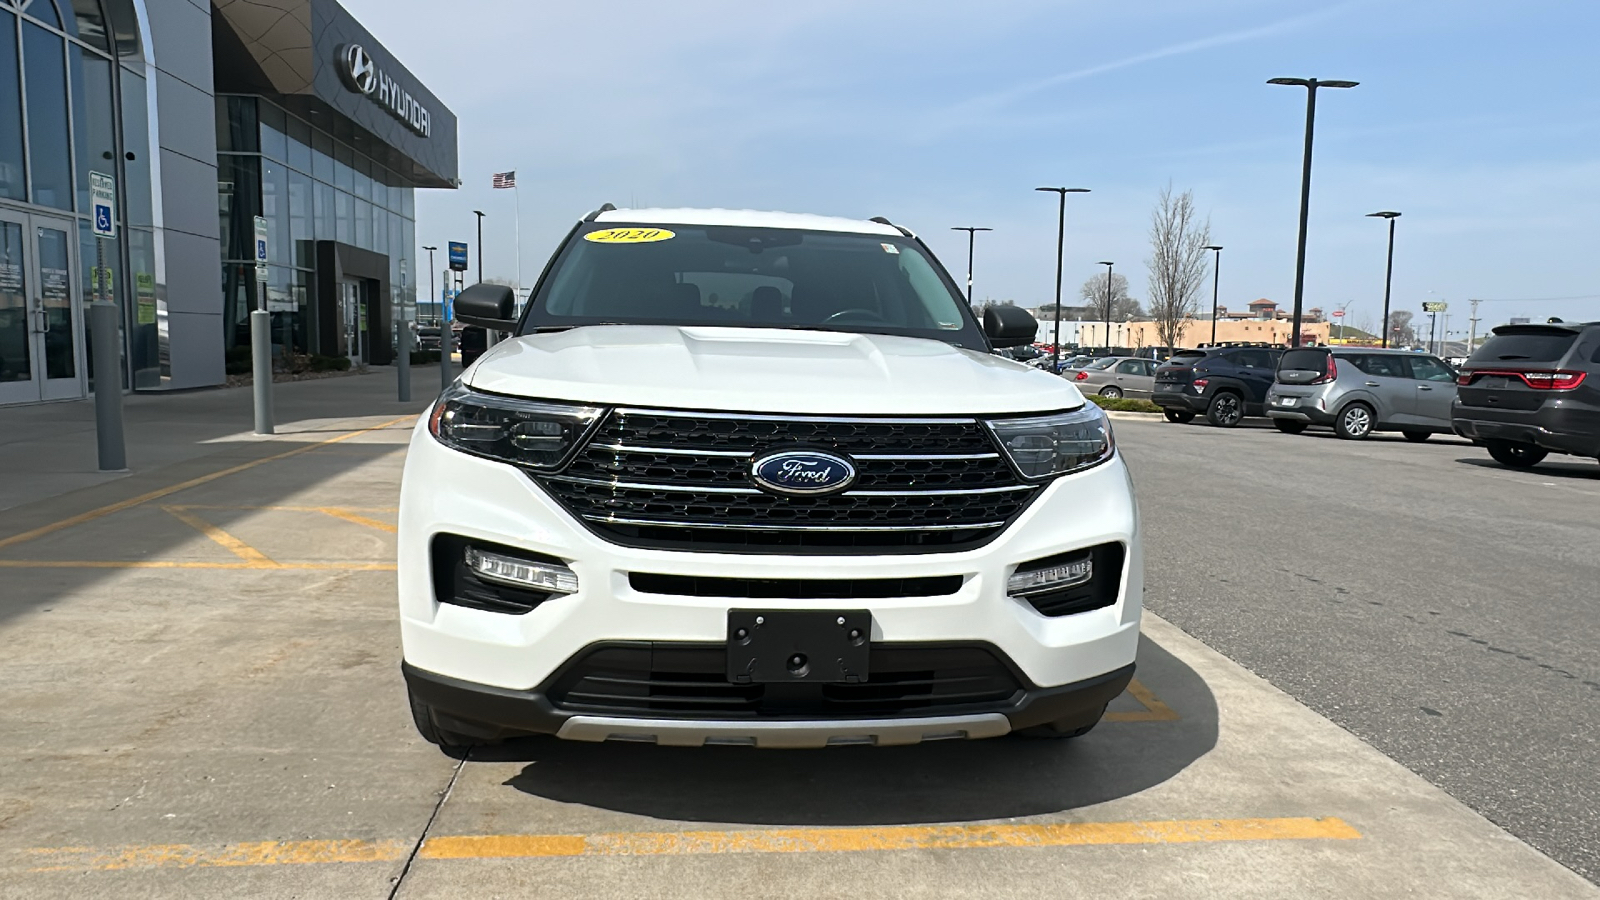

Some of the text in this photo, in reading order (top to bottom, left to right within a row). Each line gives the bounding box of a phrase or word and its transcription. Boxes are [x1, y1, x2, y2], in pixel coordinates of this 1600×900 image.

[379, 68, 431, 138] HYUNDAI
[596, 230, 661, 240] 2020
[777, 459, 832, 483] Ford
